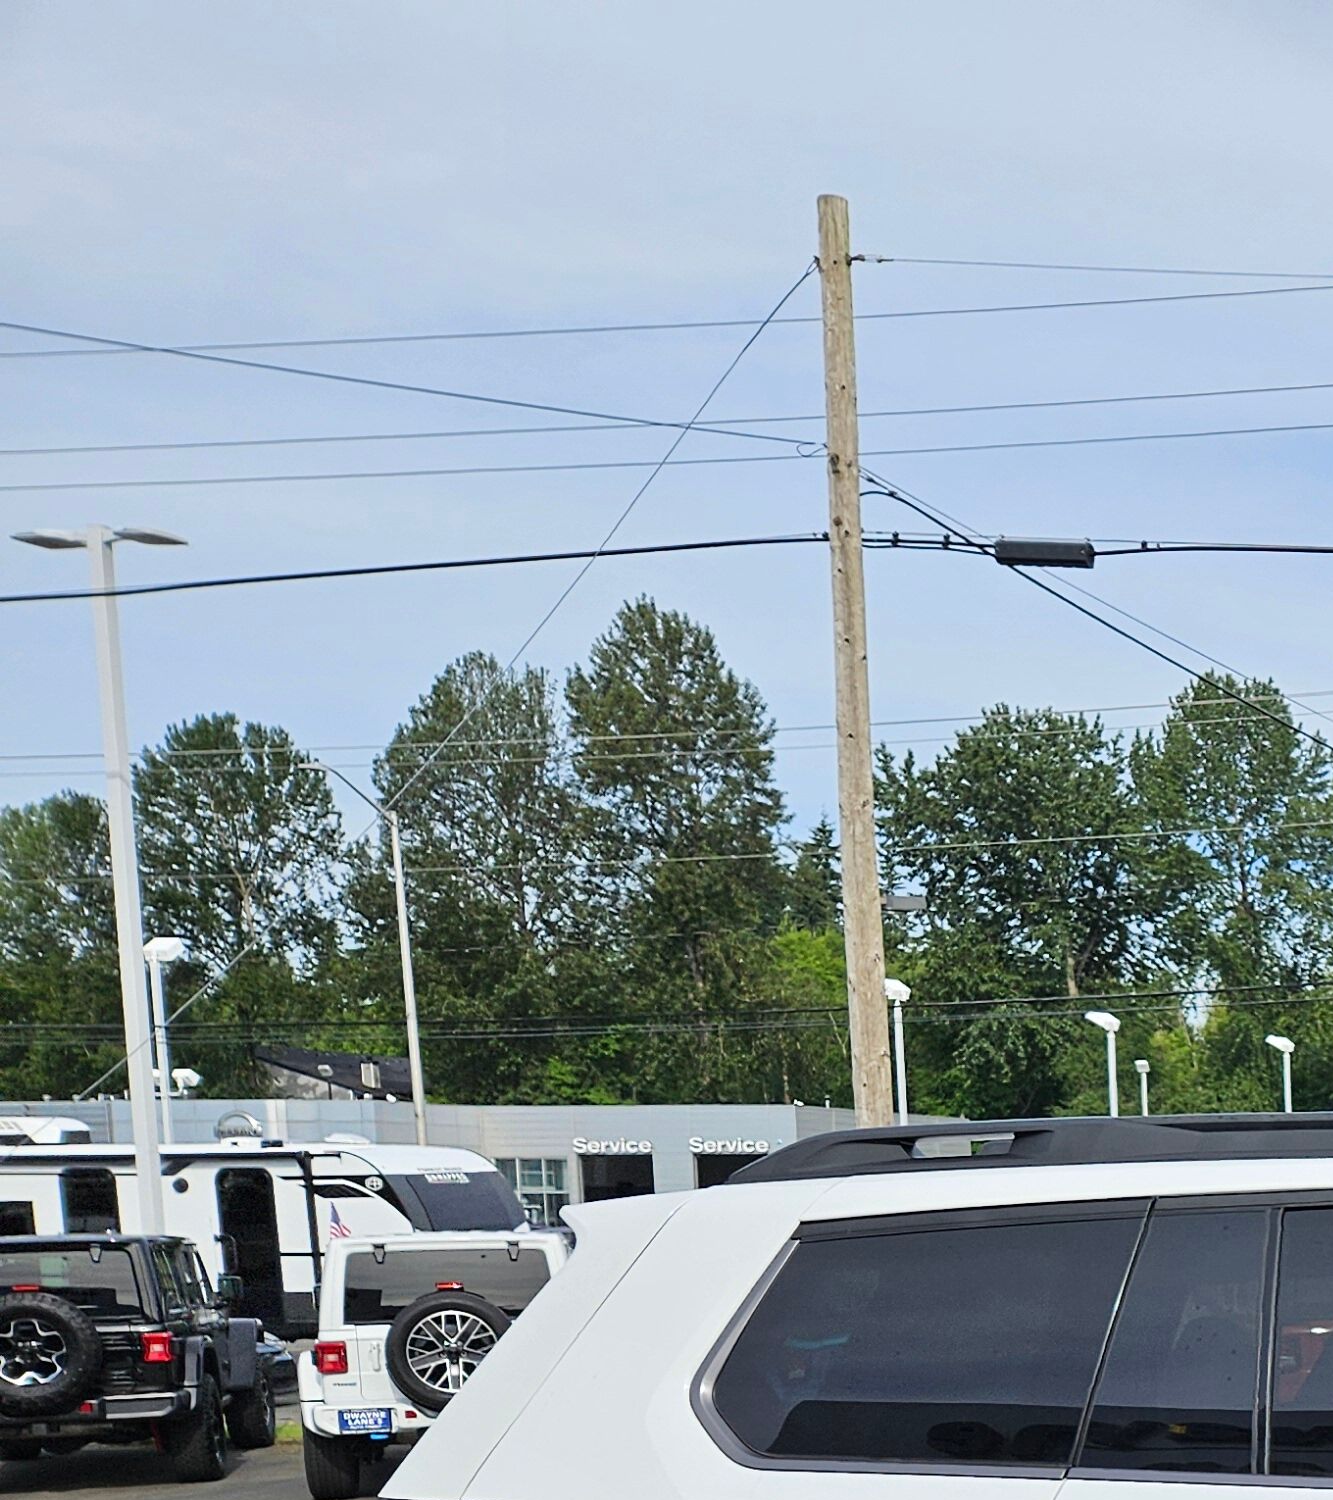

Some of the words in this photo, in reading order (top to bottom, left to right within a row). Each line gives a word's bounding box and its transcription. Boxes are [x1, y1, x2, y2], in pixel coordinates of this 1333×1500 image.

[572, 1136, 653, 1154] Service
[688, 1136, 769, 1154] Service
[343, 1411, 386, 1420] DWAYNE
